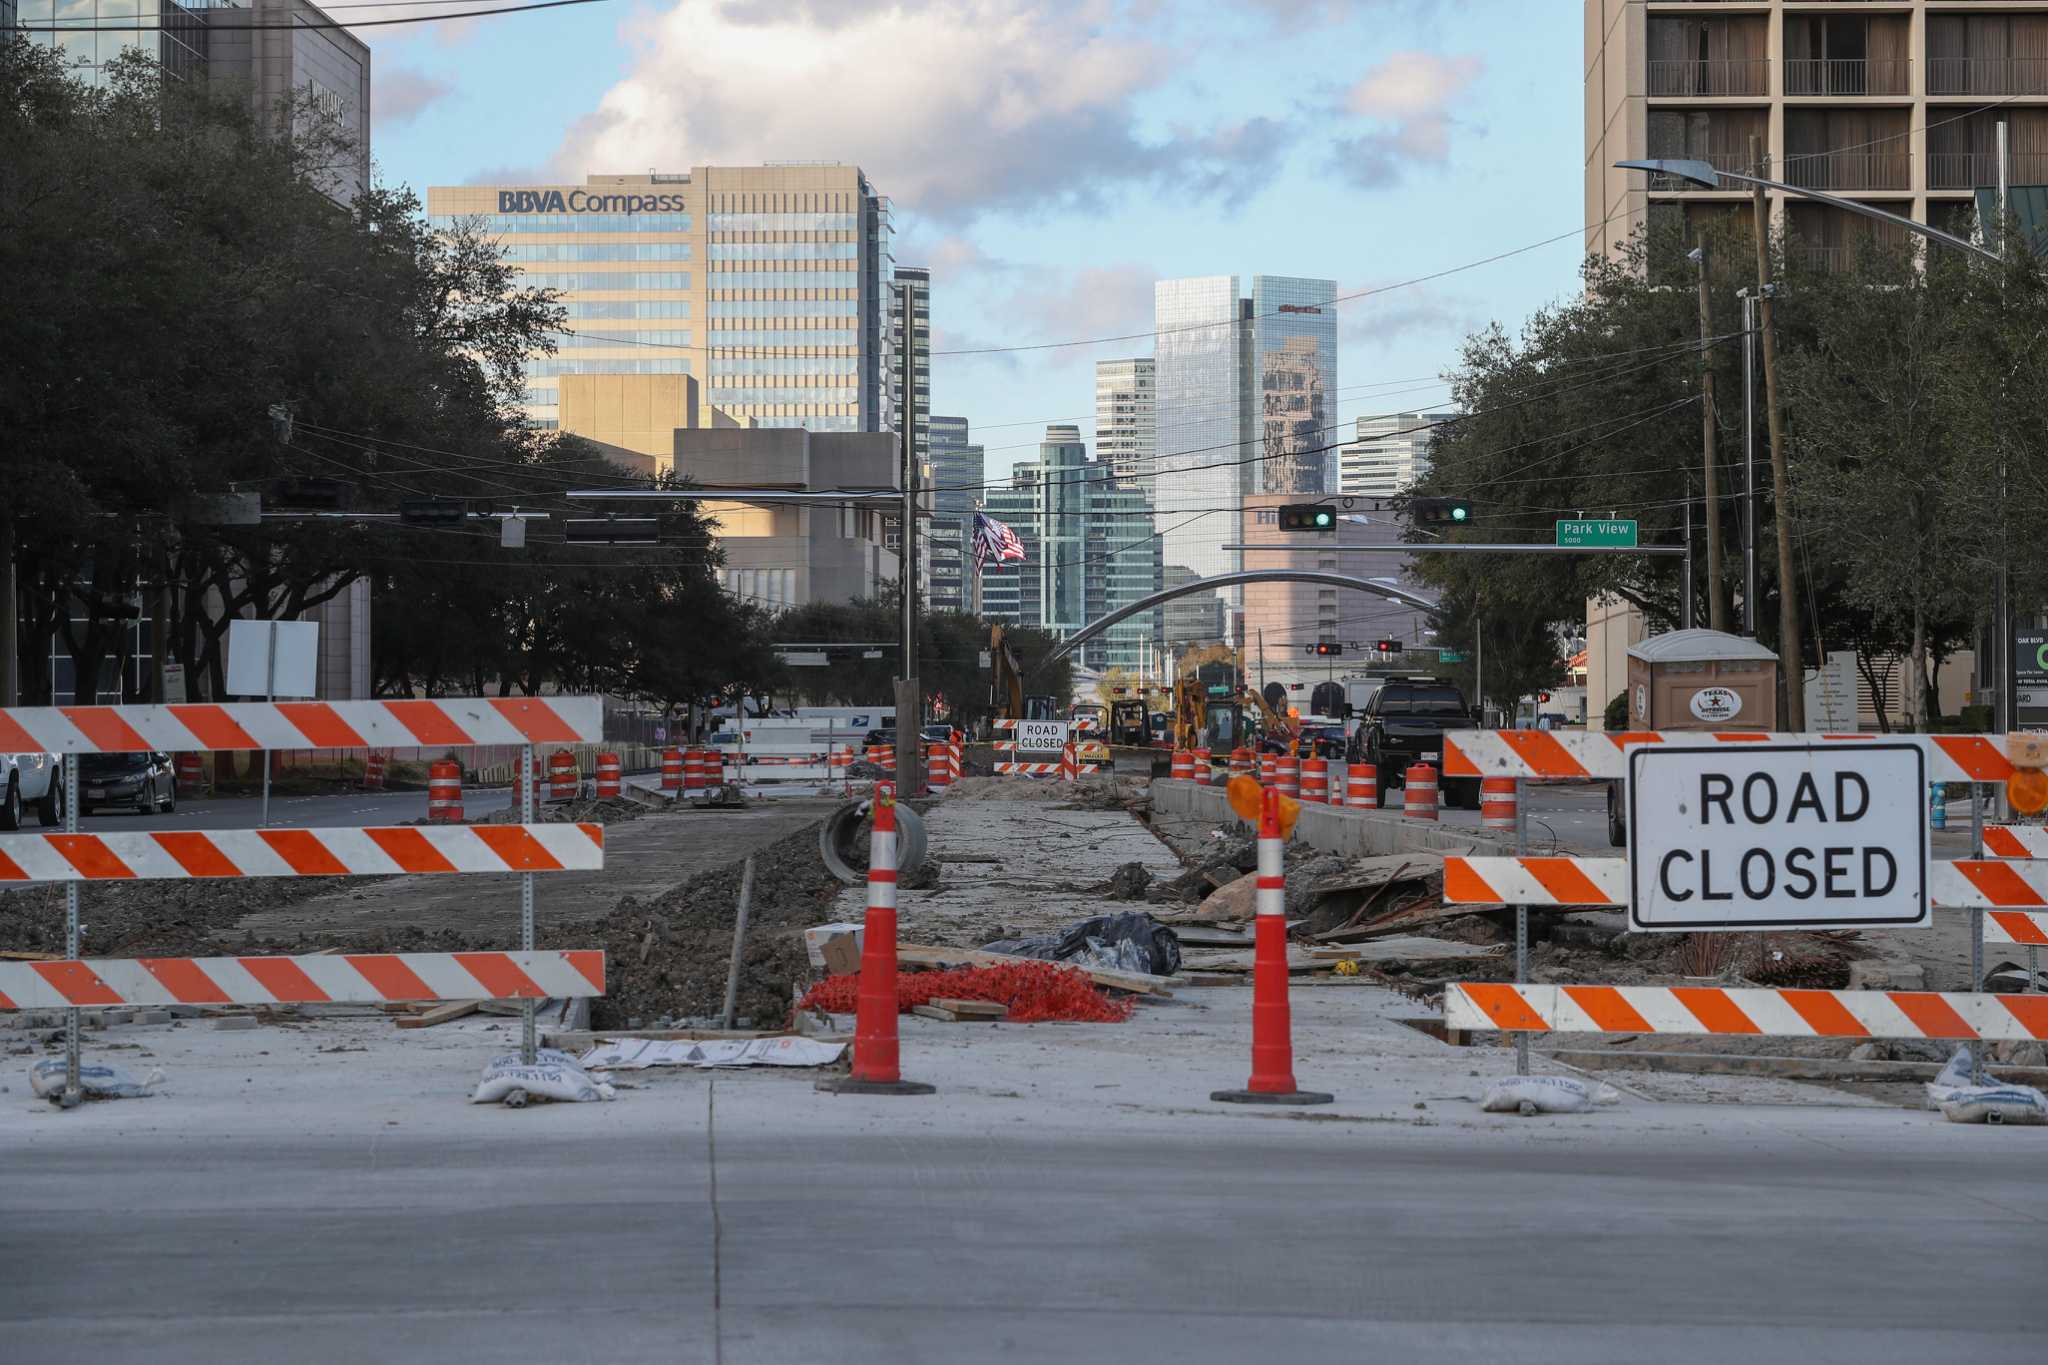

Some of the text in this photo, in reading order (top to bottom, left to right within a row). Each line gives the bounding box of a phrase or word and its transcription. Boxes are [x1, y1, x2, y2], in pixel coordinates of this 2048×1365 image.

[498, 190, 685, 216] BBVA Compass
[1564, 523, 1628, 534] Park View
[1027, 725, 1058, 735] ROAD
[1022, 738, 1064, 748] CLOSED
[1700, 771, 1870, 825] ROAD
[1660, 846, 1898, 902] CLOSED
